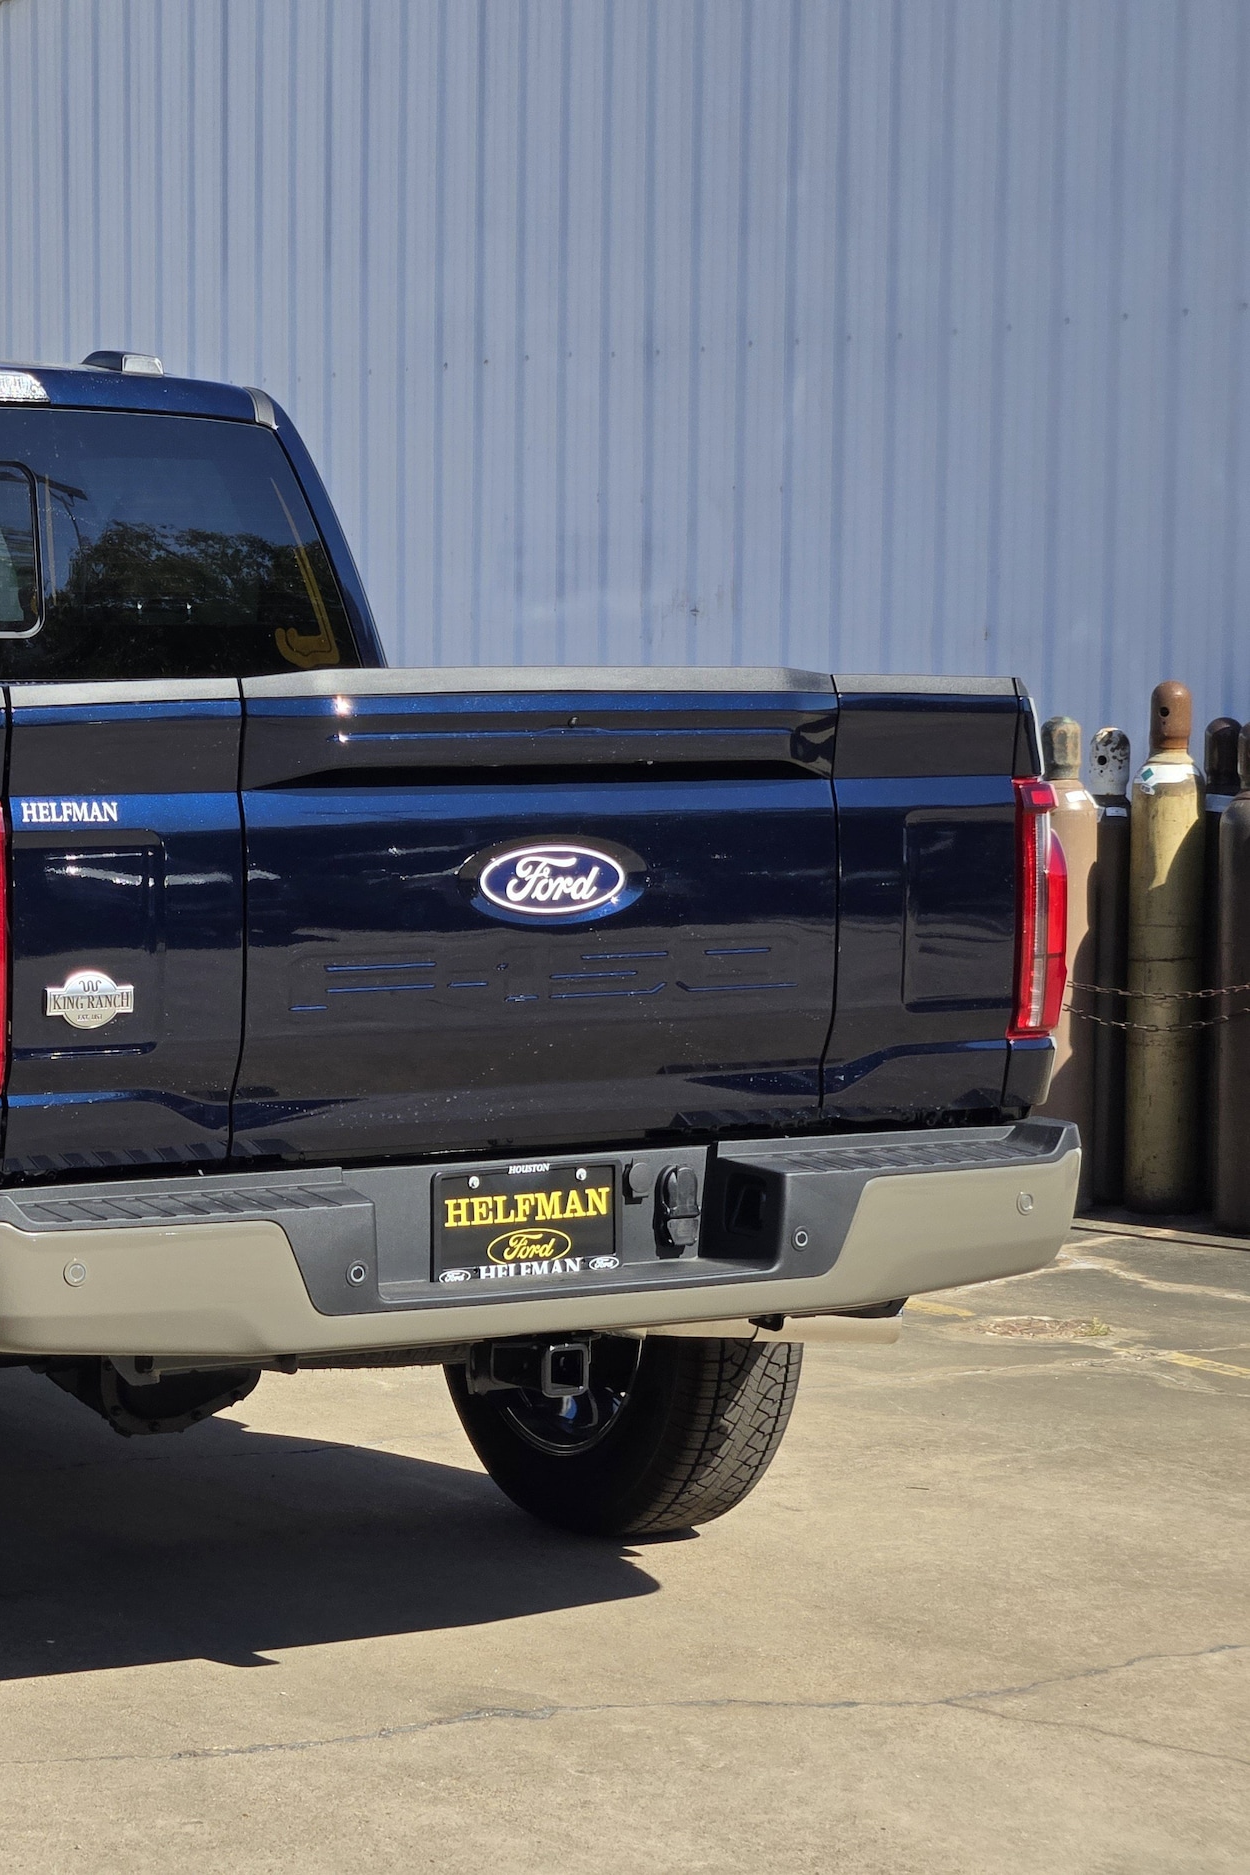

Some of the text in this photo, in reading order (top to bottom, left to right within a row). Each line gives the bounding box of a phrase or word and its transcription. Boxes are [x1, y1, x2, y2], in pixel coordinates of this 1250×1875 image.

[21, 802, 119, 823] HELFMAN
[506, 856, 600, 902] Ford
[52, 991, 130, 1010] KING RANCH
[508, 1163, 550, 1175] HOUSTON
[444, 1187, 610, 1227] HELFMAN
[503, 1233, 555, 1261] Ford
[594, 1258, 616, 1269] Ford
